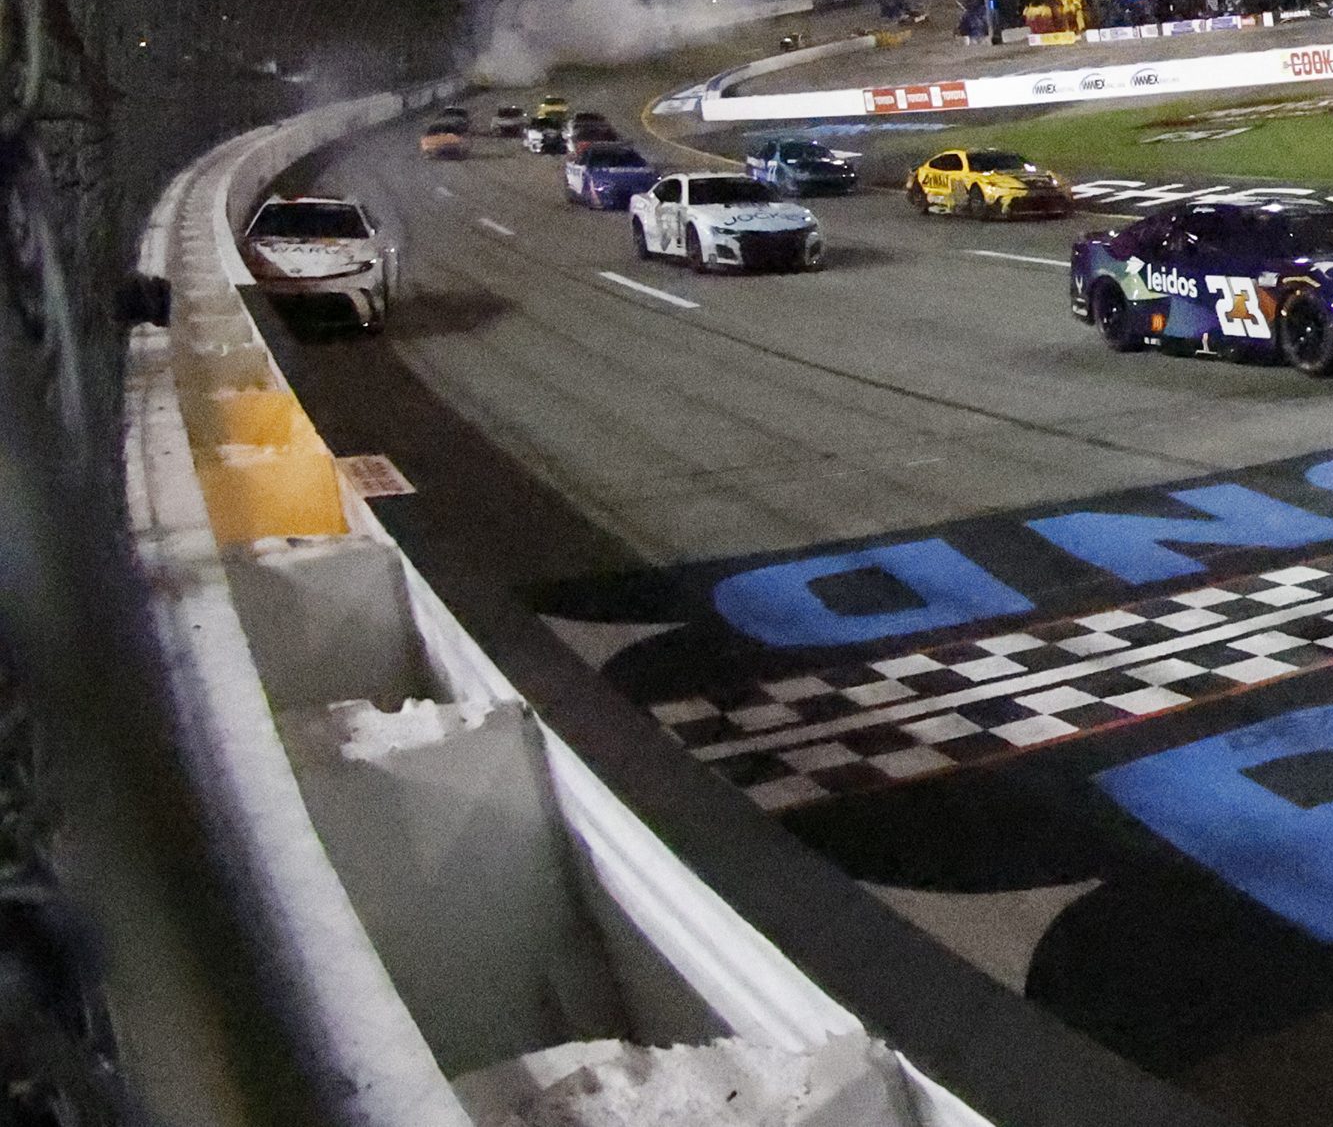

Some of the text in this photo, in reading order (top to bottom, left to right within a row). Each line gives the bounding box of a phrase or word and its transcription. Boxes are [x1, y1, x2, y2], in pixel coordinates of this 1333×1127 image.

[1291, 49, 1333, 76] COOK
[1147, 263, 1198, 298] leidos
[1205, 275, 1271, 339] 23
